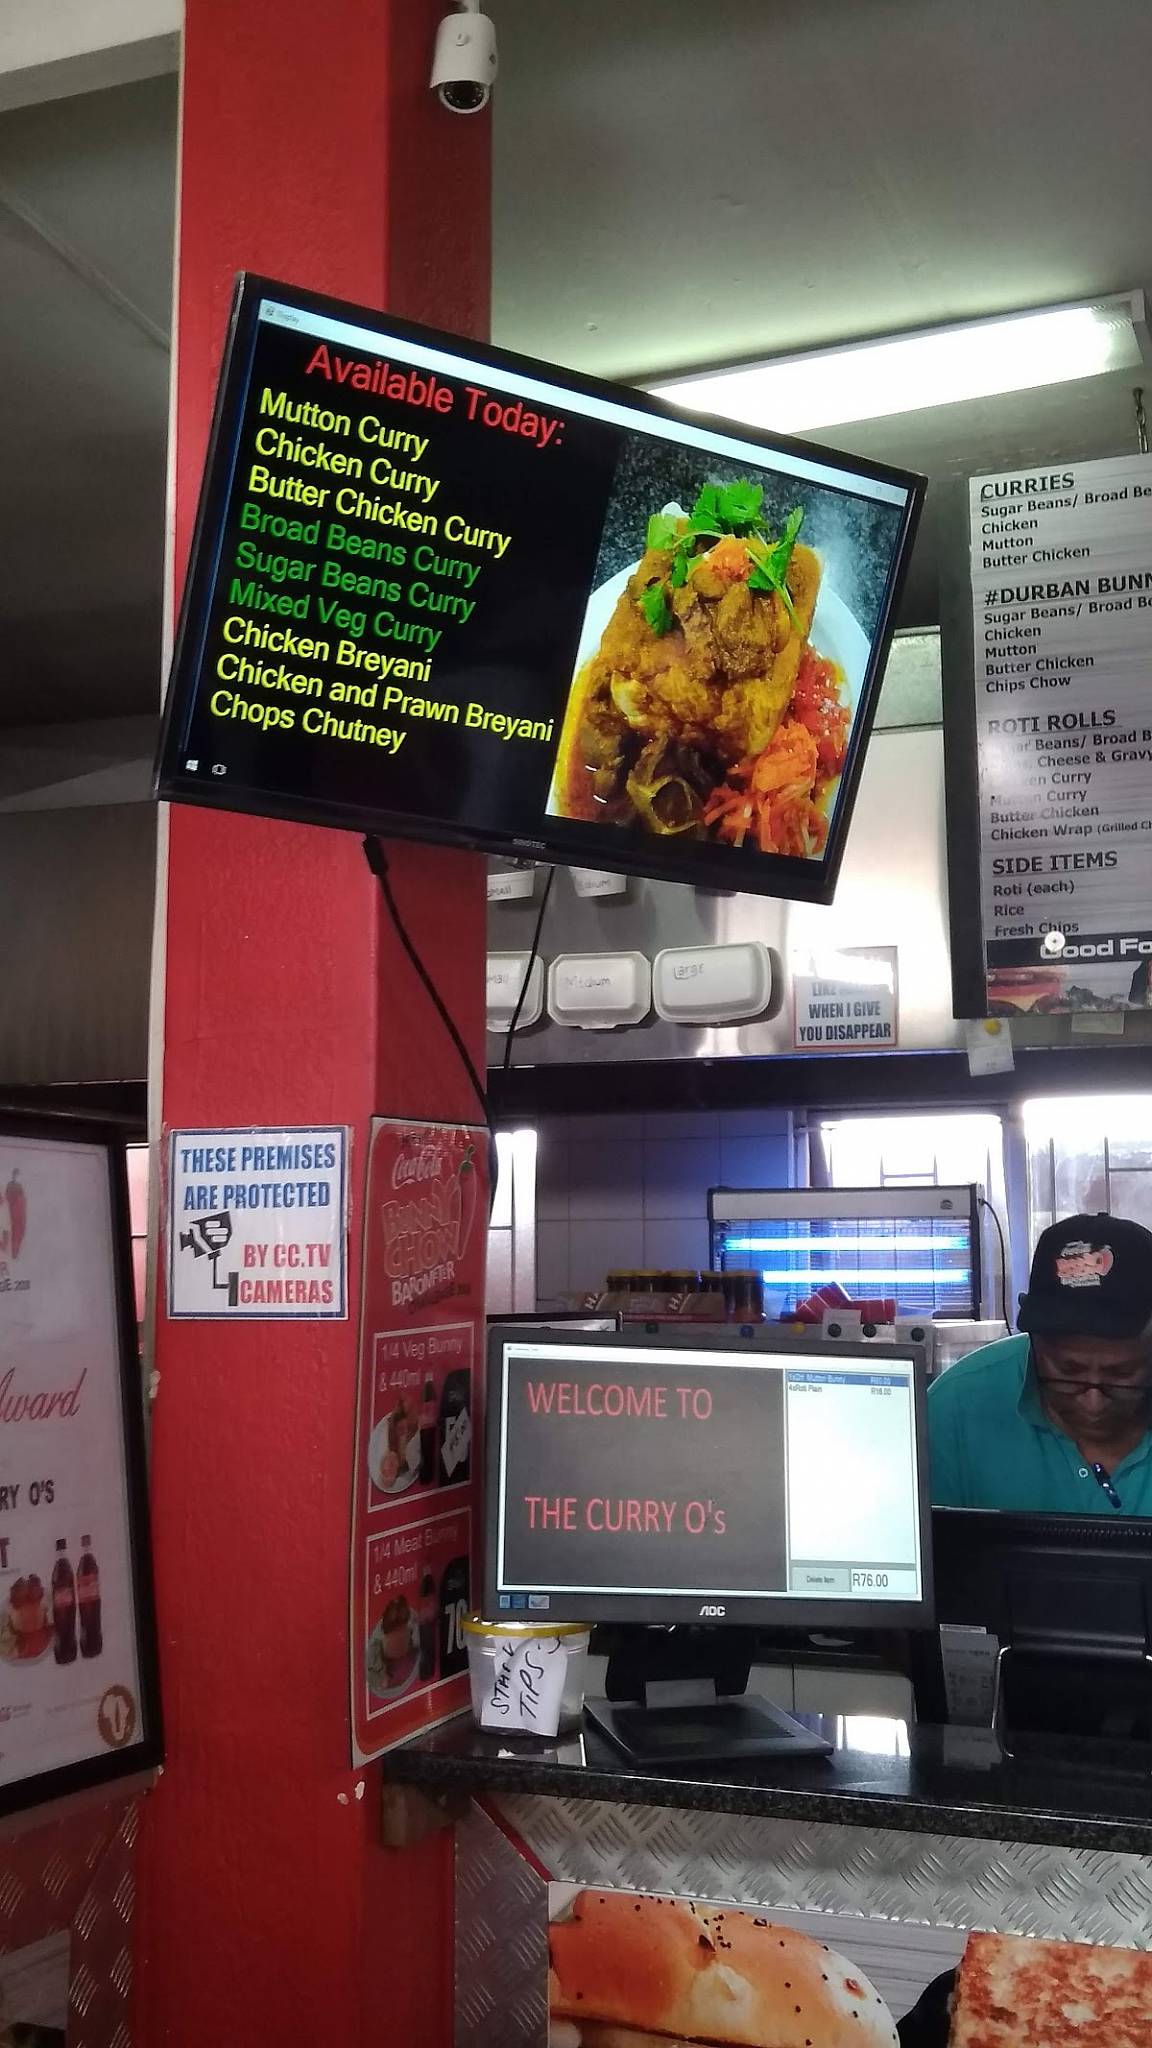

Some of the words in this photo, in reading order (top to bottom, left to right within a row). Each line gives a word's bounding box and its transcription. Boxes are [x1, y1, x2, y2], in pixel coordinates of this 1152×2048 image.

[304, 343, 453, 414] Available
[464, 386, 566, 449] Today:
[259, 387, 351, 436] Mutton
[358, 416, 430, 462] Curry
[255, 427, 362, 478] Chicken
[369, 457, 441, 504] Curry
[980, 471, 1075, 499] CURRIES
[249, 465, 330, 509] Butter
[335, 488, 437, 537] Chicken
[444, 516, 512, 558] Curry
[981, 503, 1023, 519] Sugar
[1028, 494, 1078, 512] Beans/
[1085, 487, 1128, 504] Broad
[981, 518, 1038, 534] Chicken
[240, 502, 321, 546] Broad
[326, 523, 407, 567] Beans
[413, 546, 482, 589] Curry
[982, 536, 1033, 551] Mutton
[983, 554, 1028, 569] Butter
[1032, 546, 1090, 563] Chicken
[235, 541, 316, 584] Sugar
[321, 561, 402, 603] Beans
[408, 582, 477, 624] Curry
[985, 579, 1090, 606] #DURBAN
[229, 578, 309, 620] Mixed
[318, 597, 367, 638] Veg
[374, 611, 443, 653] Curry
[984, 610, 1026, 626] Sugar
[1031, 603, 1082, 620] Beans/
[1088, 597, 1132, 613] Broad
[984, 625, 1041, 641] Chicken
[223, 616, 329, 663] Chicken
[336, 640, 433, 683] Breyani
[985, 643, 1037, 659] Mutton
[986, 660, 1031, 676] Butter
[1035, 655, 1094, 671] Chicken
[986, 678, 1025, 694] Chips
[1030, 674, 1071, 690] Chow
[216, 653, 323, 697] Chicken
[329, 682, 377, 708] and
[383, 686, 460, 724] Prawn
[464, 702, 555, 743] Breyani
[210, 690, 296, 731] Chops
[302, 707, 407, 755] Chutney
[988, 716, 1040, 735] ROTI
[1047, 709, 1116, 731] ROLLS
[1035, 734, 1087, 751] Beans/
[1093, 730, 1136, 746] Broad
[1038, 752, 1091, 768] Cheese
[1095, 750, 1106, 763] &
[1051, 771, 1092, 785] Curry
[1046, 790, 1087, 803] Curry
[990, 811, 1036, 824] Butter
[1040, 805, 1099, 821] Chicken
[991, 826, 1048, 841] Chicken
[1053, 823, 1093, 837] Wrap
[1097, 821, 1137, 835] (Grilled
[992, 856, 1043, 875] SIDE
[1050, 850, 1118, 871] ITEMS
[993, 883, 1022, 897] Roti
[1027, 879, 1075, 896] (each)
[994, 903, 1025, 917] Rice
[995, 923, 1034, 937] Fresh
[1039, 921, 1080, 935] Chips
[808, 1002, 844, 1019] WHEN
[846, 1002, 851, 1018] I
[854, 1001, 881, 1017] GIVE
[799, 1025, 823, 1042] YOU
[825, 1022, 891, 1041] DISAPPEAR
[181, 1147, 237, 1173] THESE
[241, 1143, 336, 1172] PREMISES
[183, 1184, 219, 1211] ARE
[223, 1181, 331, 1210] PROTECTED
[243, 1243, 269, 1268] BY
[273, 1243, 332, 1268] CC.TV
[239, 1279, 334, 1304] CAMERAS
[402, 1340, 426, 1360] Veg
[527, 1381, 668, 1419] WELCOME
[676, 1387, 713, 1420] TO
[29, 1479, 55, 1506] O'S
[525, 1495, 578, 1531] THE
[585, 1497, 677, 1533] CURRY
[684, 1500, 727, 1535] O's
[394, 1536, 422, 1556] Meat
[374, 1574, 383, 1595] &
[852, 1572, 889, 1588] R76.00
[699, 1605, 726, 1617] AOC
[519, 1650, 545, 1719] TIPS
